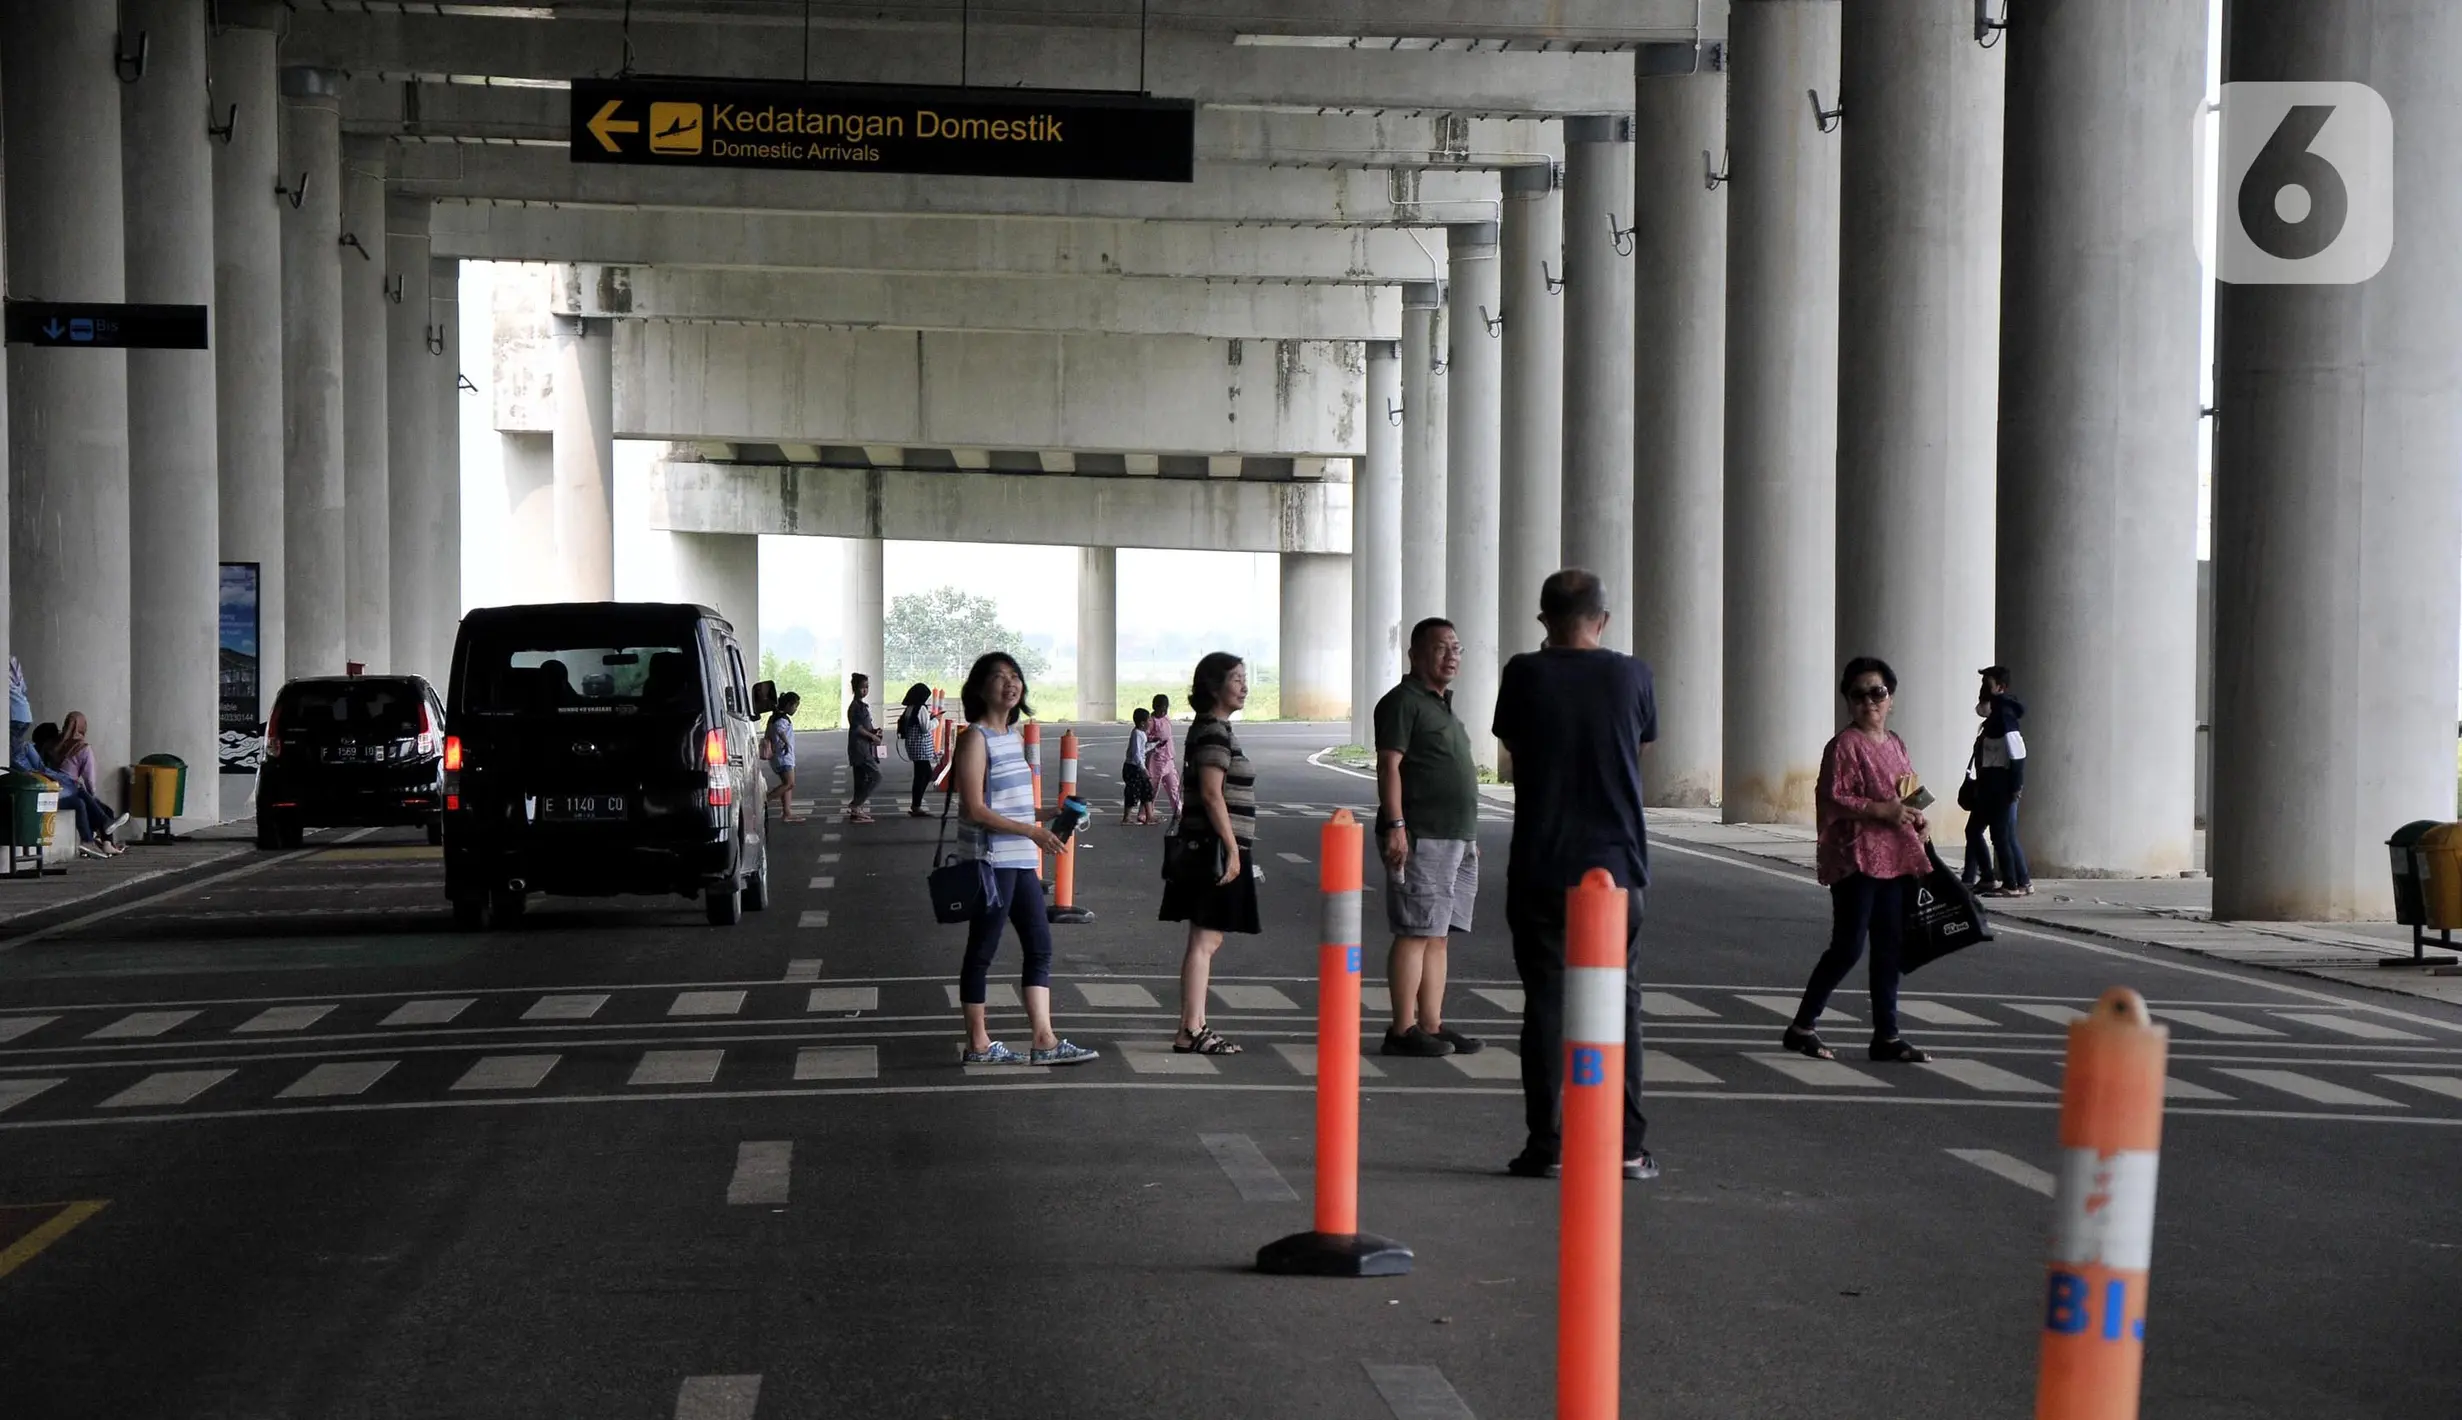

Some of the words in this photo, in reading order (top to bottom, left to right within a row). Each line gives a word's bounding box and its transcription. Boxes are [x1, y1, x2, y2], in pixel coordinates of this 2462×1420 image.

[712, 103, 904, 141] Kedatangan
[916, 109, 1064, 143] Domestik
[712, 139, 804, 160] Domestic
[807, 143, 881, 163] Arrivals
[96, 318, 119, 332] Bis
[545, 797, 554, 812] E
[567, 796, 595, 811] 1140
[1572, 1048, 1604, 1086] B
